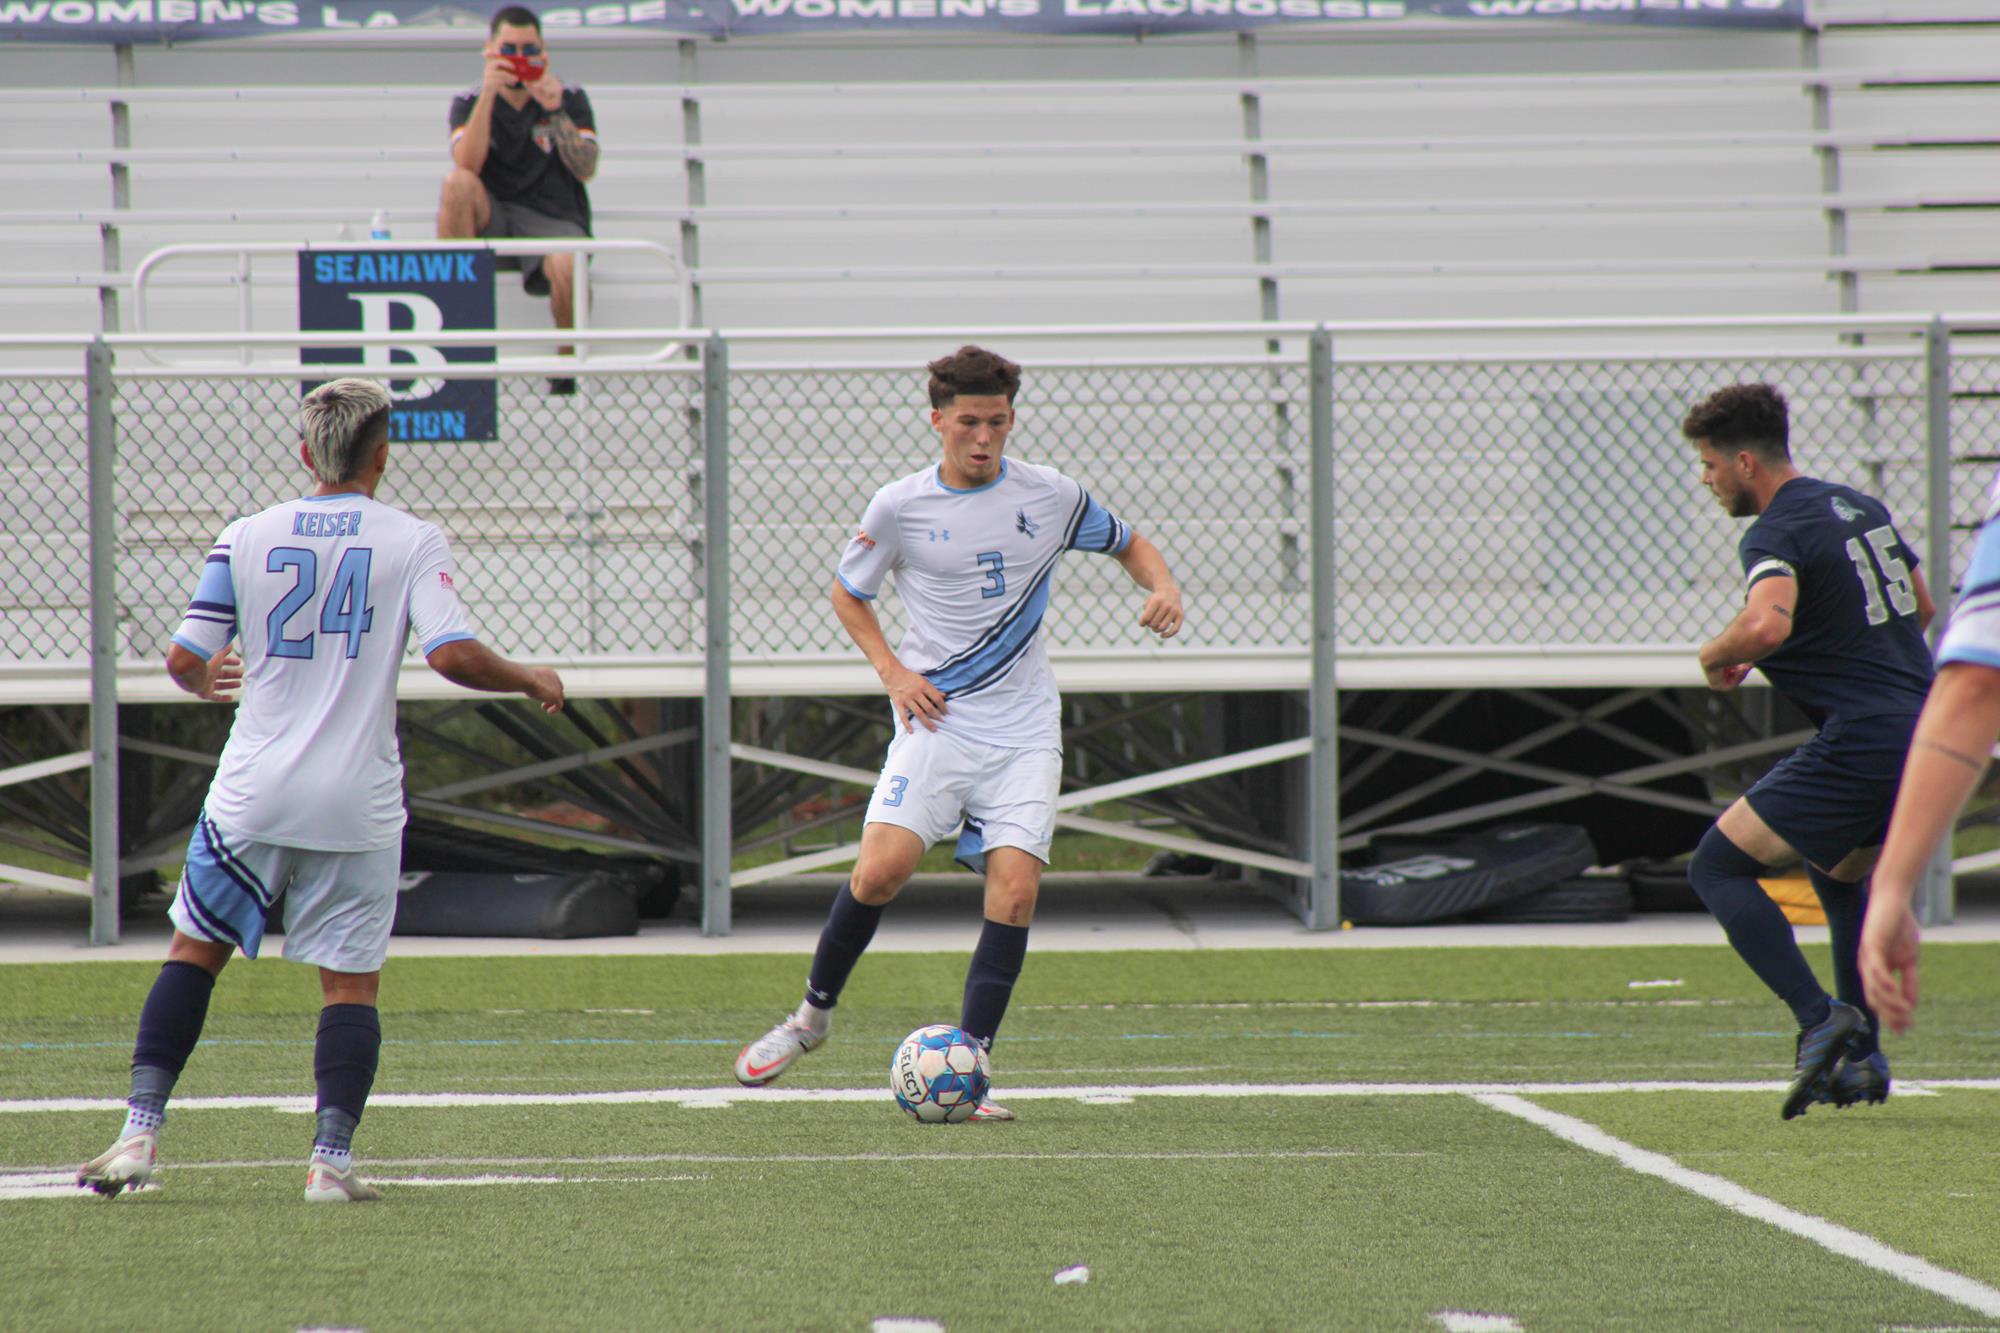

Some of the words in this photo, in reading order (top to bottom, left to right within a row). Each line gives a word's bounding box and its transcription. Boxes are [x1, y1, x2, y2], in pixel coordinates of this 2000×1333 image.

[0, 1, 299, 25] WOMEN'S
[315, 254, 477, 283] SEAHAWK
[347, 292, 448, 401] B
[387, 410, 466, 439] TION
[291, 510, 363, 537] KEISER
[976, 551, 1006, 599] 3
[1845, 524, 1918, 626] 15
[265, 546, 375, 660] 24
[883, 775, 910, 808] 3
[900, 1045, 923, 1098] SELECT
